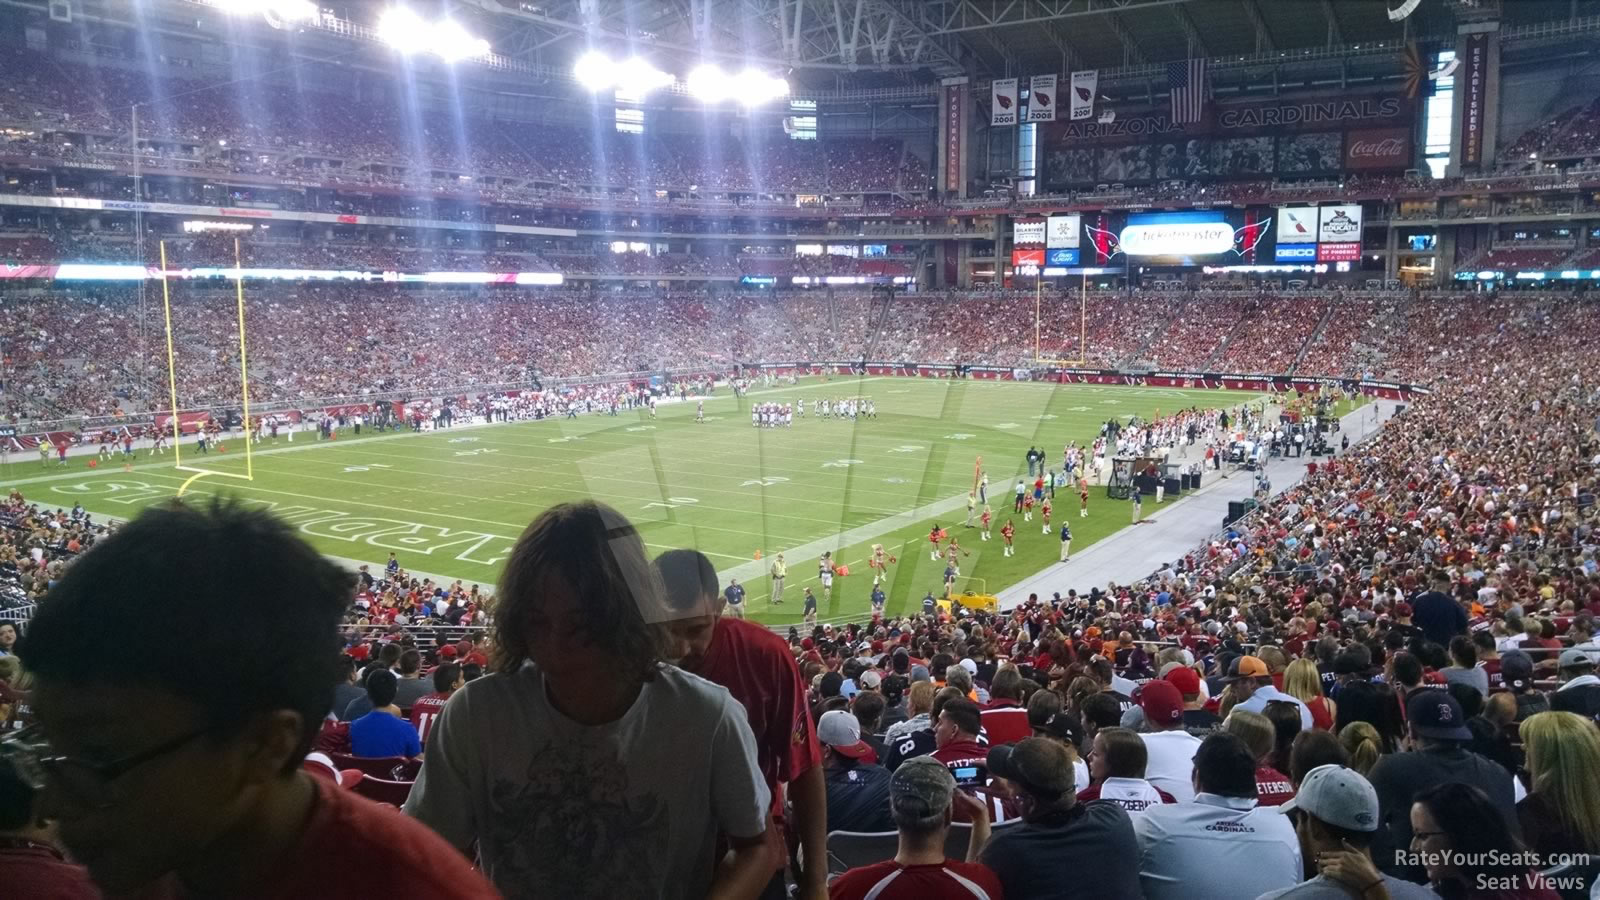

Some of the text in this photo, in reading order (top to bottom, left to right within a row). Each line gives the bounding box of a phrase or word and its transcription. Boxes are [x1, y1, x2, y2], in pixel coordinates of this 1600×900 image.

[1470, 48, 1480, 131] ESTABLISHED
[1062, 98, 1400, 140] ARIZONA CARDINALS
[1256, 782, 1294, 794] ETERSON
